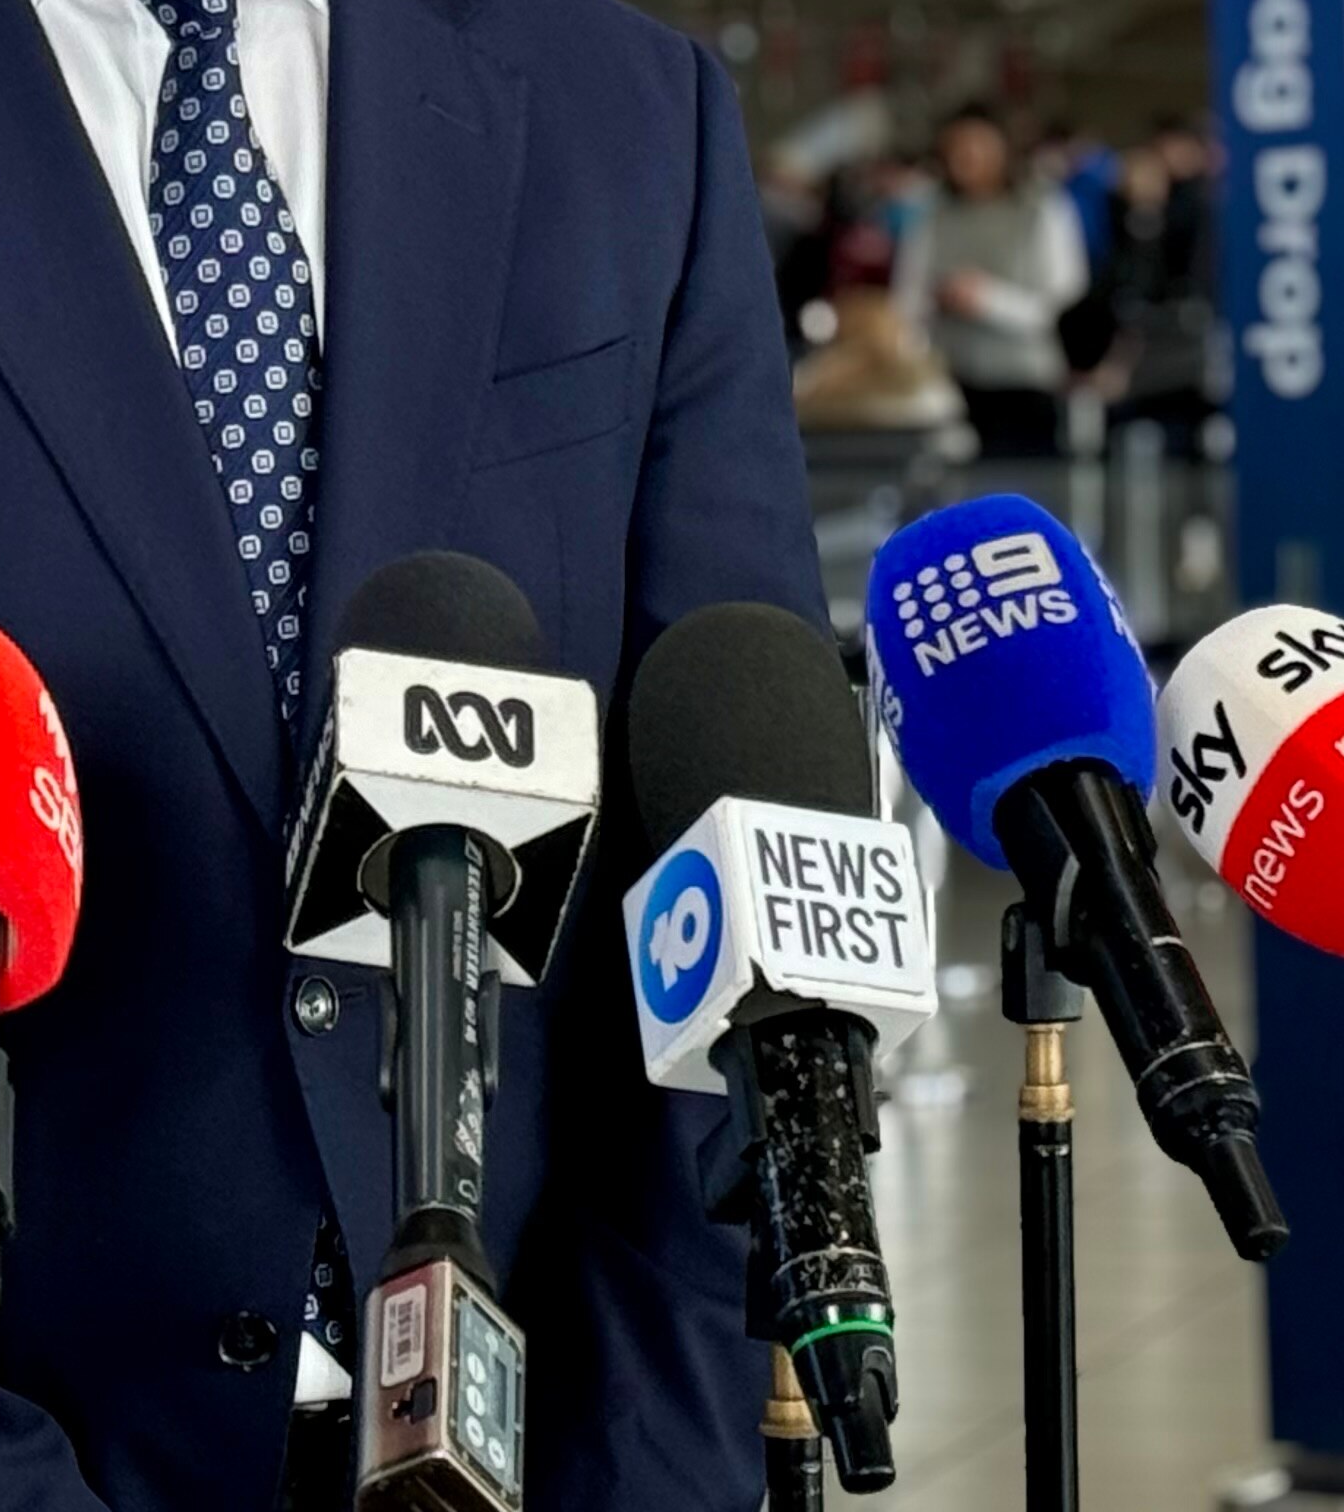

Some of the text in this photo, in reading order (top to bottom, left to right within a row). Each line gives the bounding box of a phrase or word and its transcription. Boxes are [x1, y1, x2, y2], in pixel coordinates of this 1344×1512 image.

[1245, 146, 1326, 396] Drop
[971, 532, 1062, 597] 9
[912, 589, 1078, 677] NEWS
[1169, 700, 1247, 835] sky
[754, 827, 903, 905] NEWS
[1242, 778, 1325, 910] news
[649, 885, 711, 992] 10
[764, 894, 908, 969] FIRST
